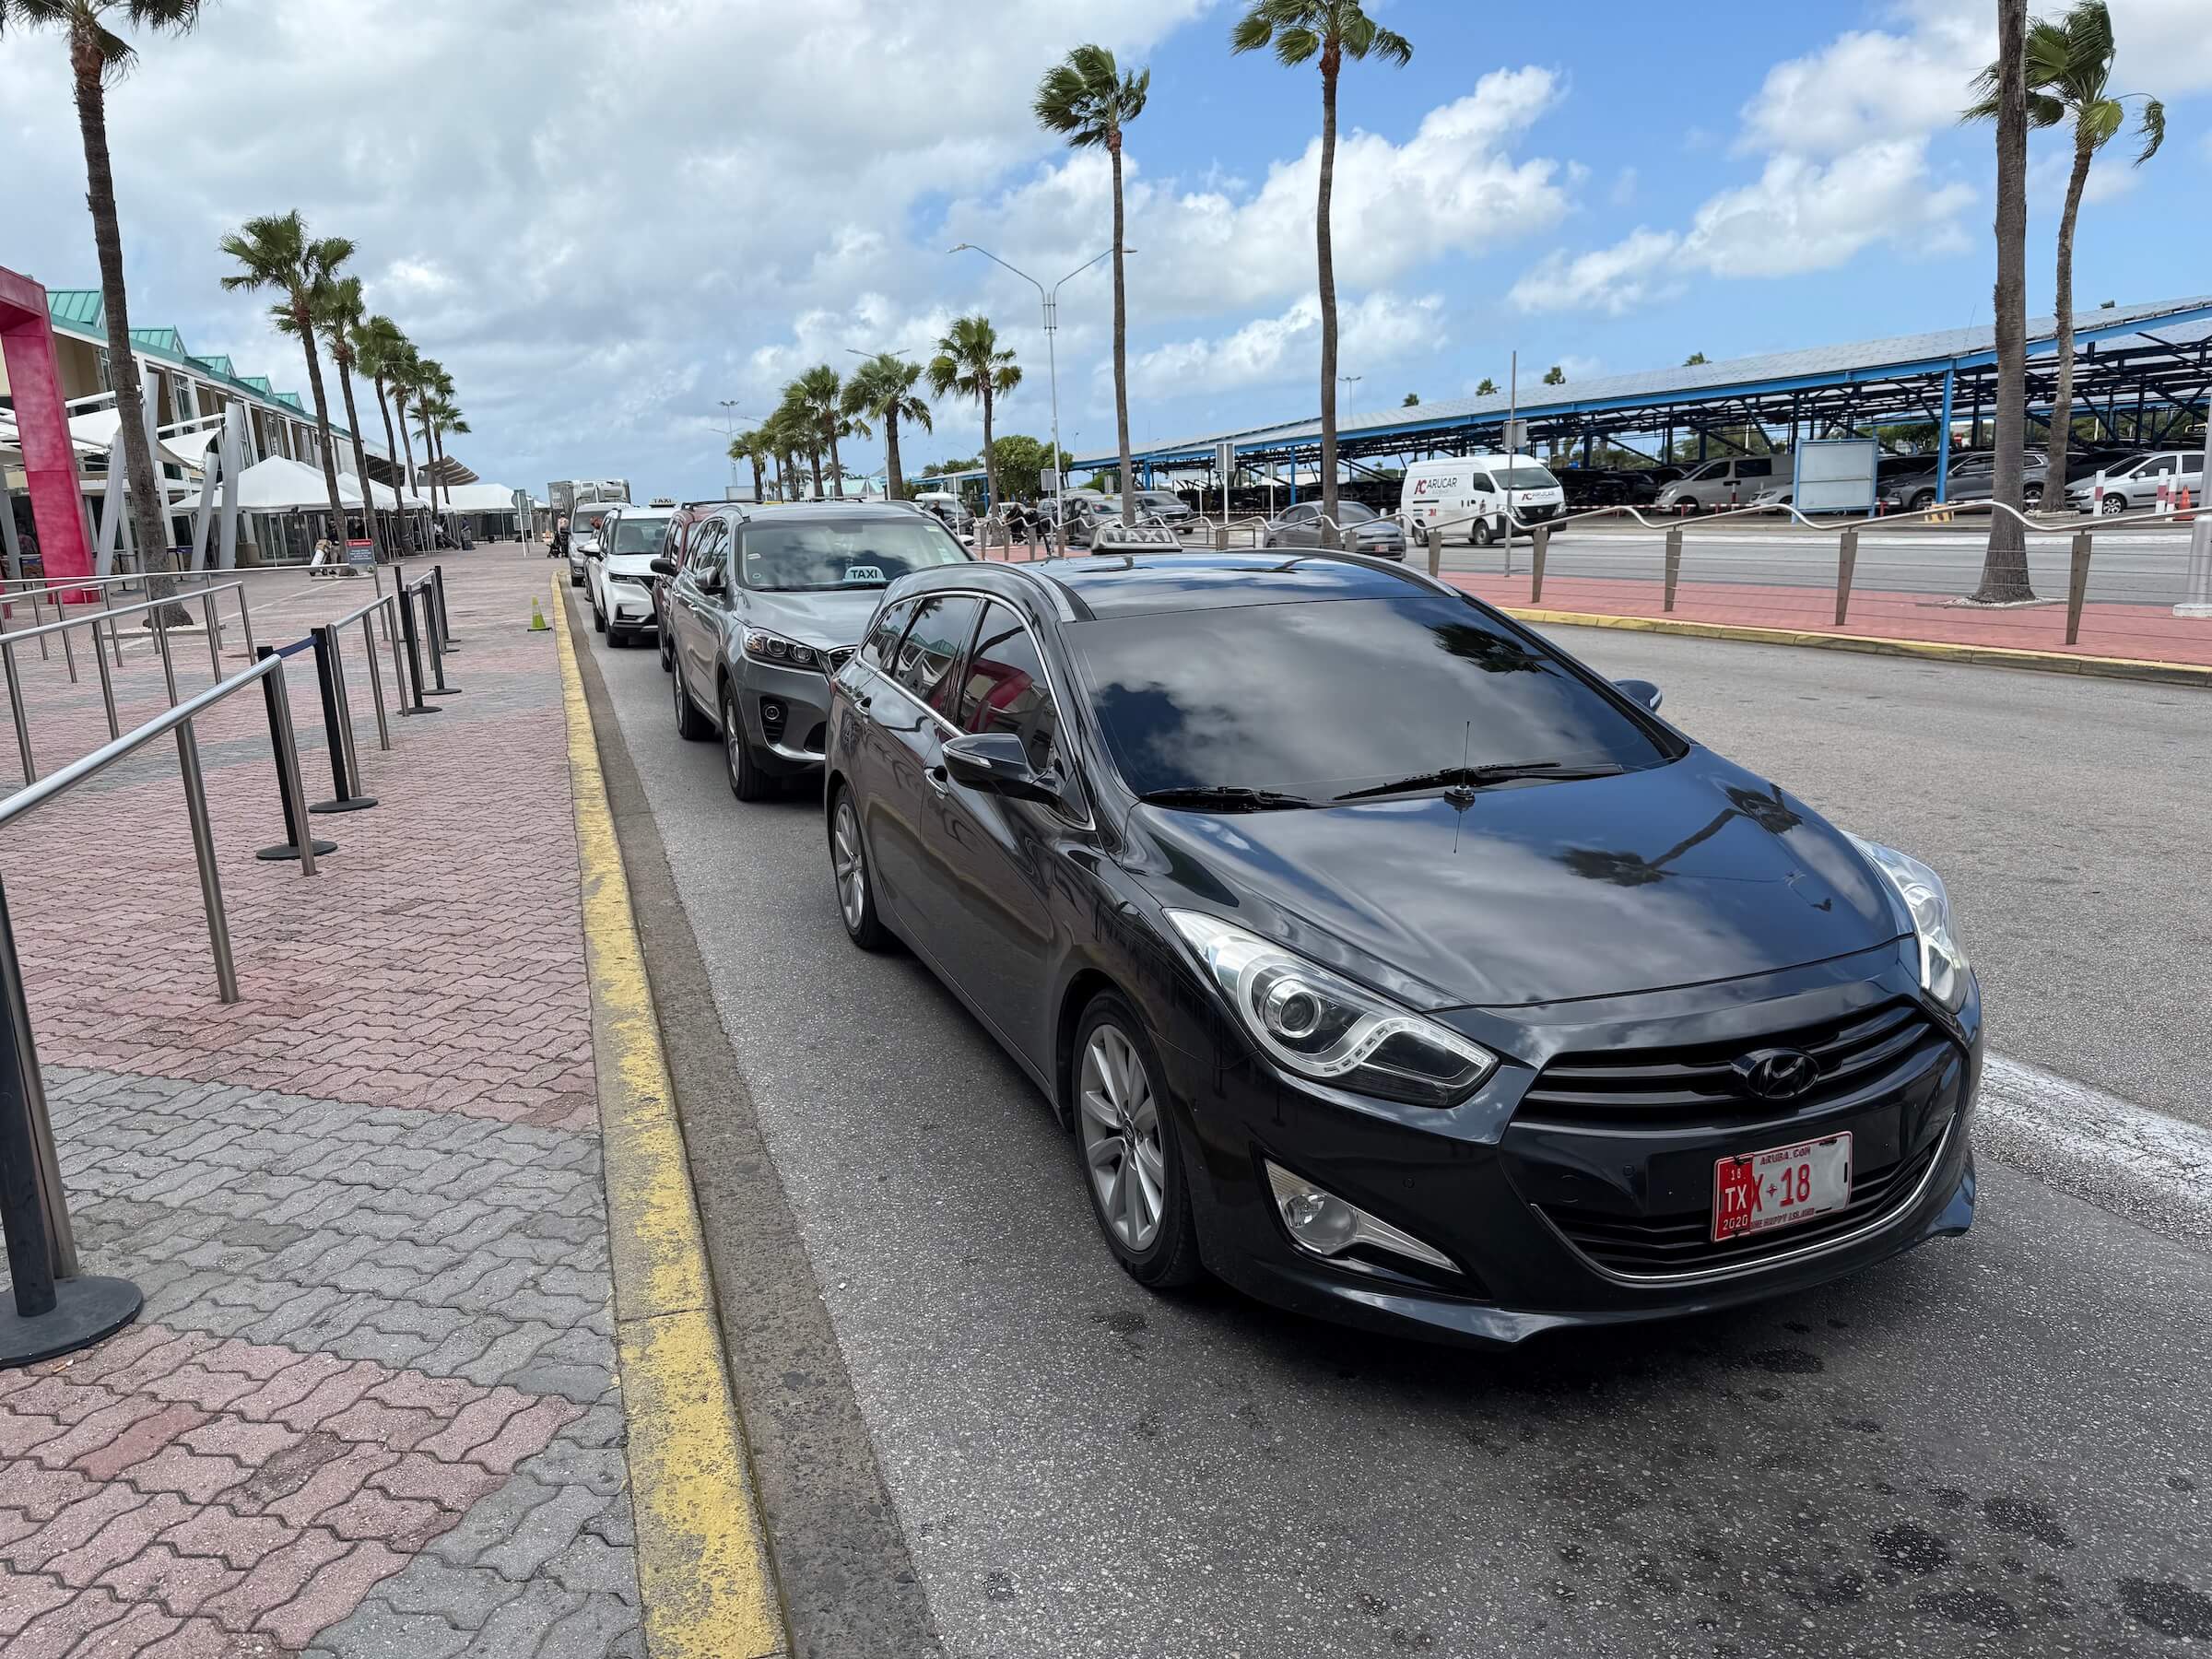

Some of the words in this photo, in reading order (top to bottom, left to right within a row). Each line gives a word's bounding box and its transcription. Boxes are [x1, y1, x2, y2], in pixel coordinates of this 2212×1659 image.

[1427, 477, 1457, 488] ARUCAR
[1106, 529, 1171, 543] TAXI
[850, 570, 877, 579] TAXI
[1724, 1183, 1747, 1213] TX
[1723, 1215, 1748, 1231] 2020
